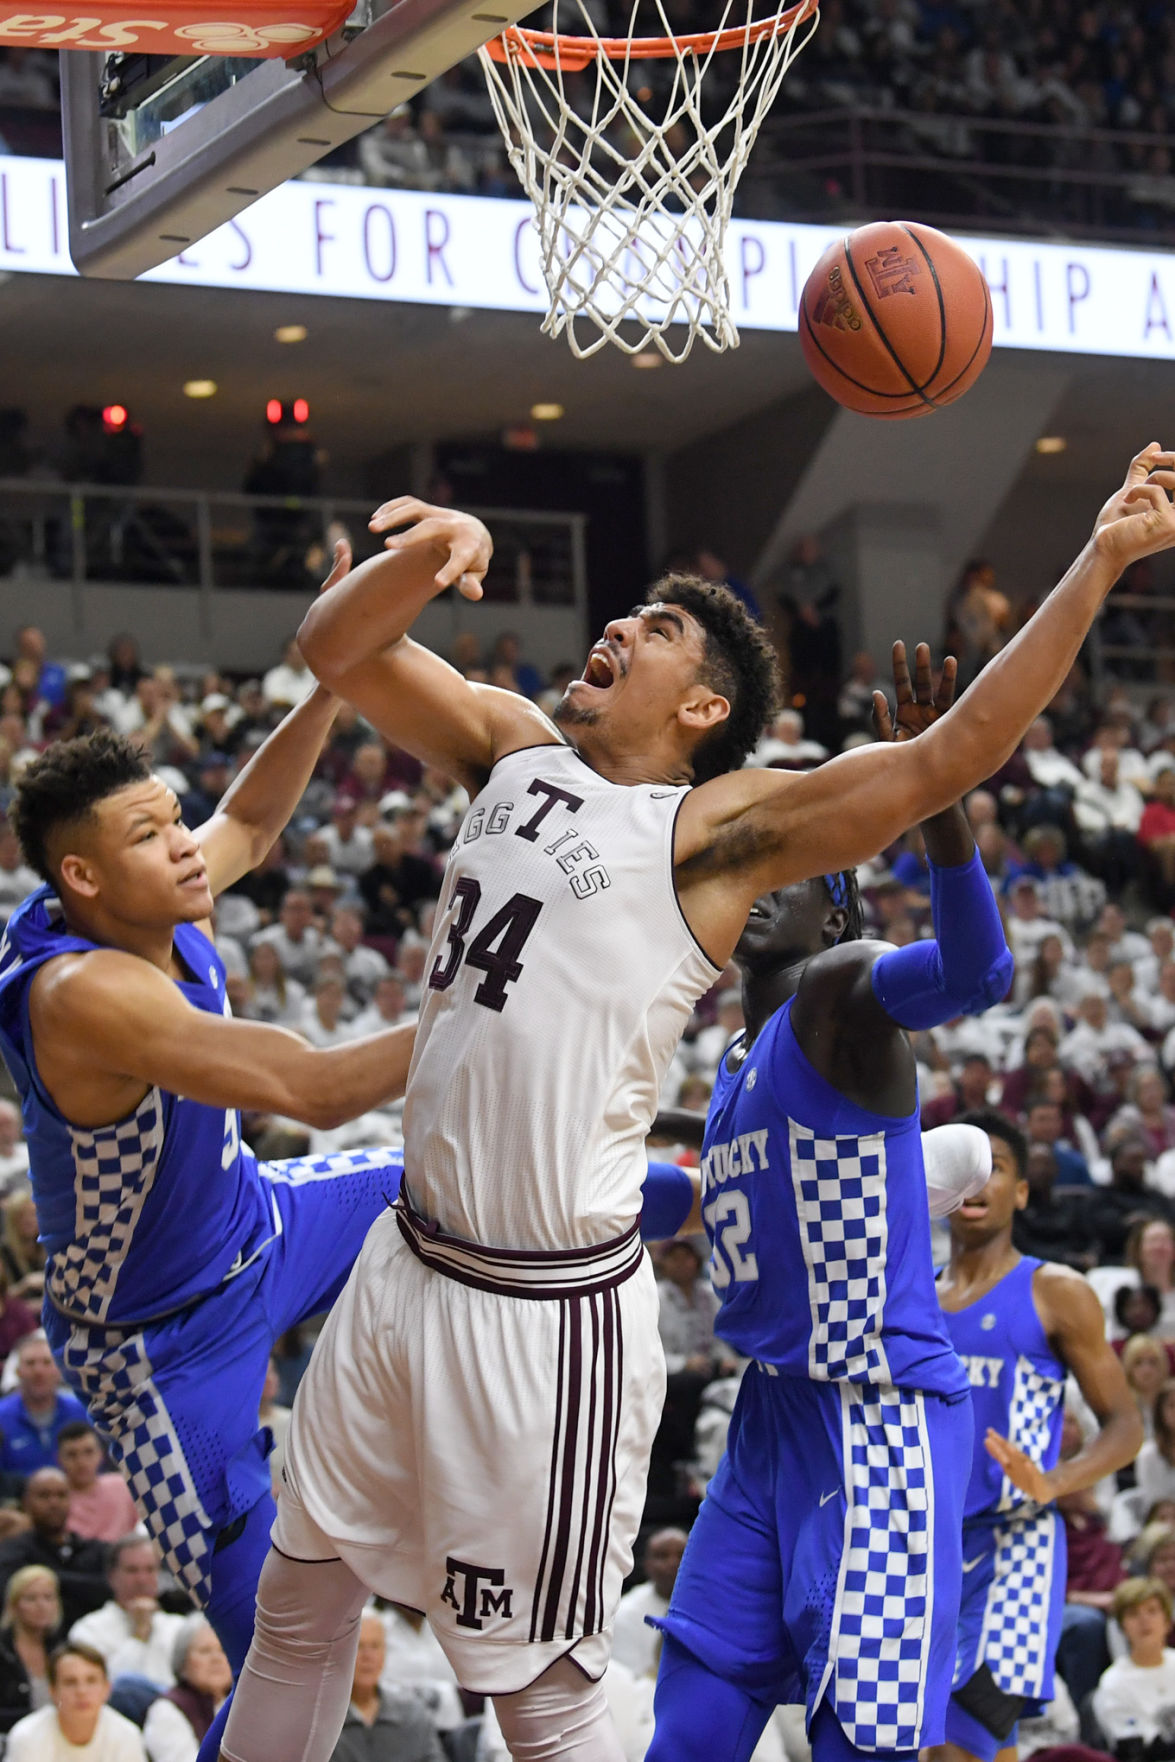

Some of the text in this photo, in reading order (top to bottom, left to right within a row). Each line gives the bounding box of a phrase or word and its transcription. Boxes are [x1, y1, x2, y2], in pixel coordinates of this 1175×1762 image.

[313, 200, 455, 287] FOR
[1143, 270, 1173, 341] A
[428, 877, 544, 1013] 34
